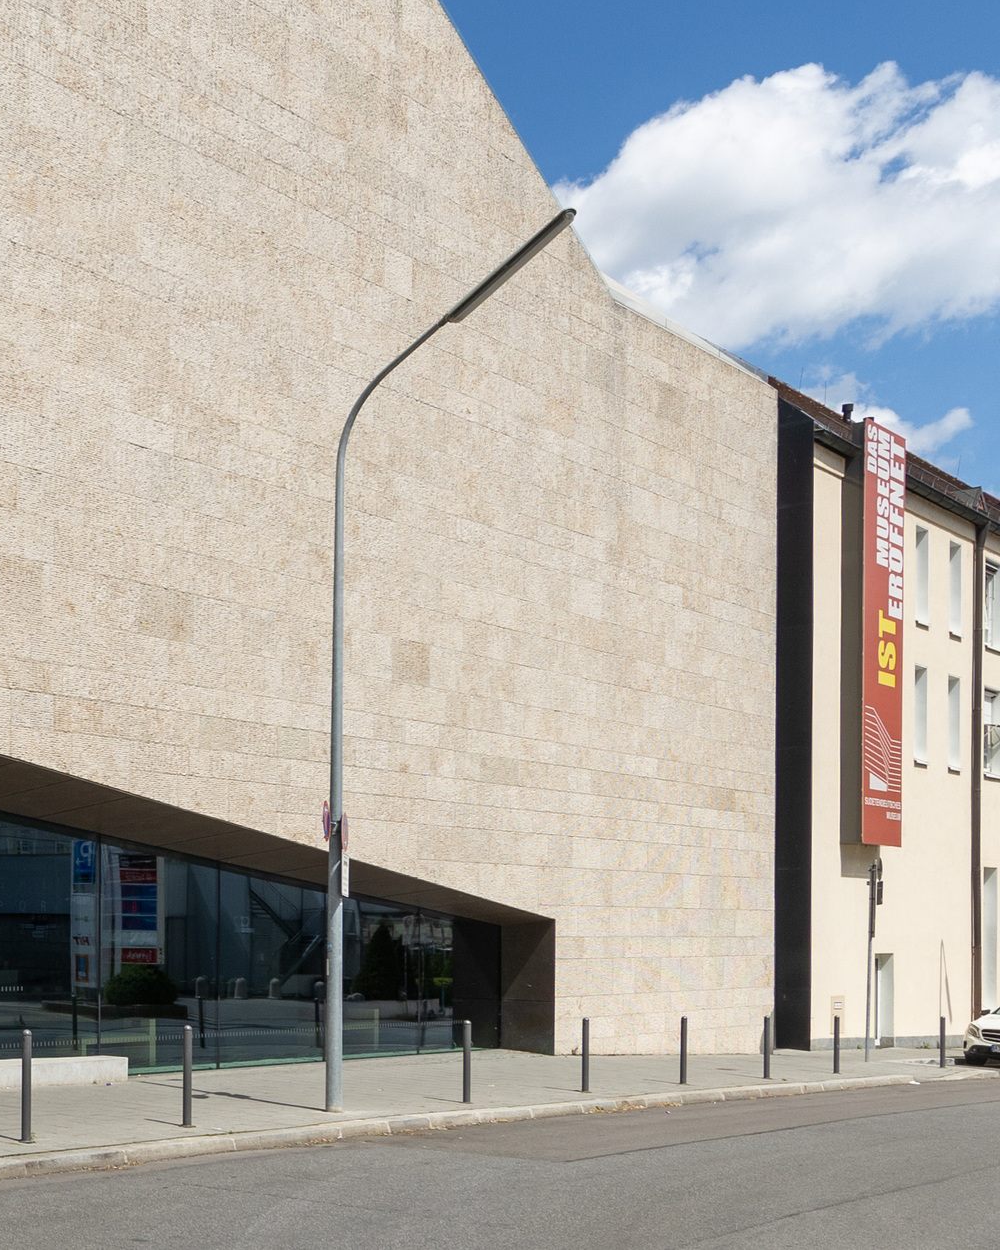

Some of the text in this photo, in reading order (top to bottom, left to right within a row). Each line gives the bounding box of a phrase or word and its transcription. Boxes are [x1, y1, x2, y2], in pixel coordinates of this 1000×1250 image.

[867, 424, 877, 475] DAS
[876, 428, 890, 568] MUSEUM
[888, 435, 905, 621] ERÖFFNET
[878, 609, 896, 688] IST
